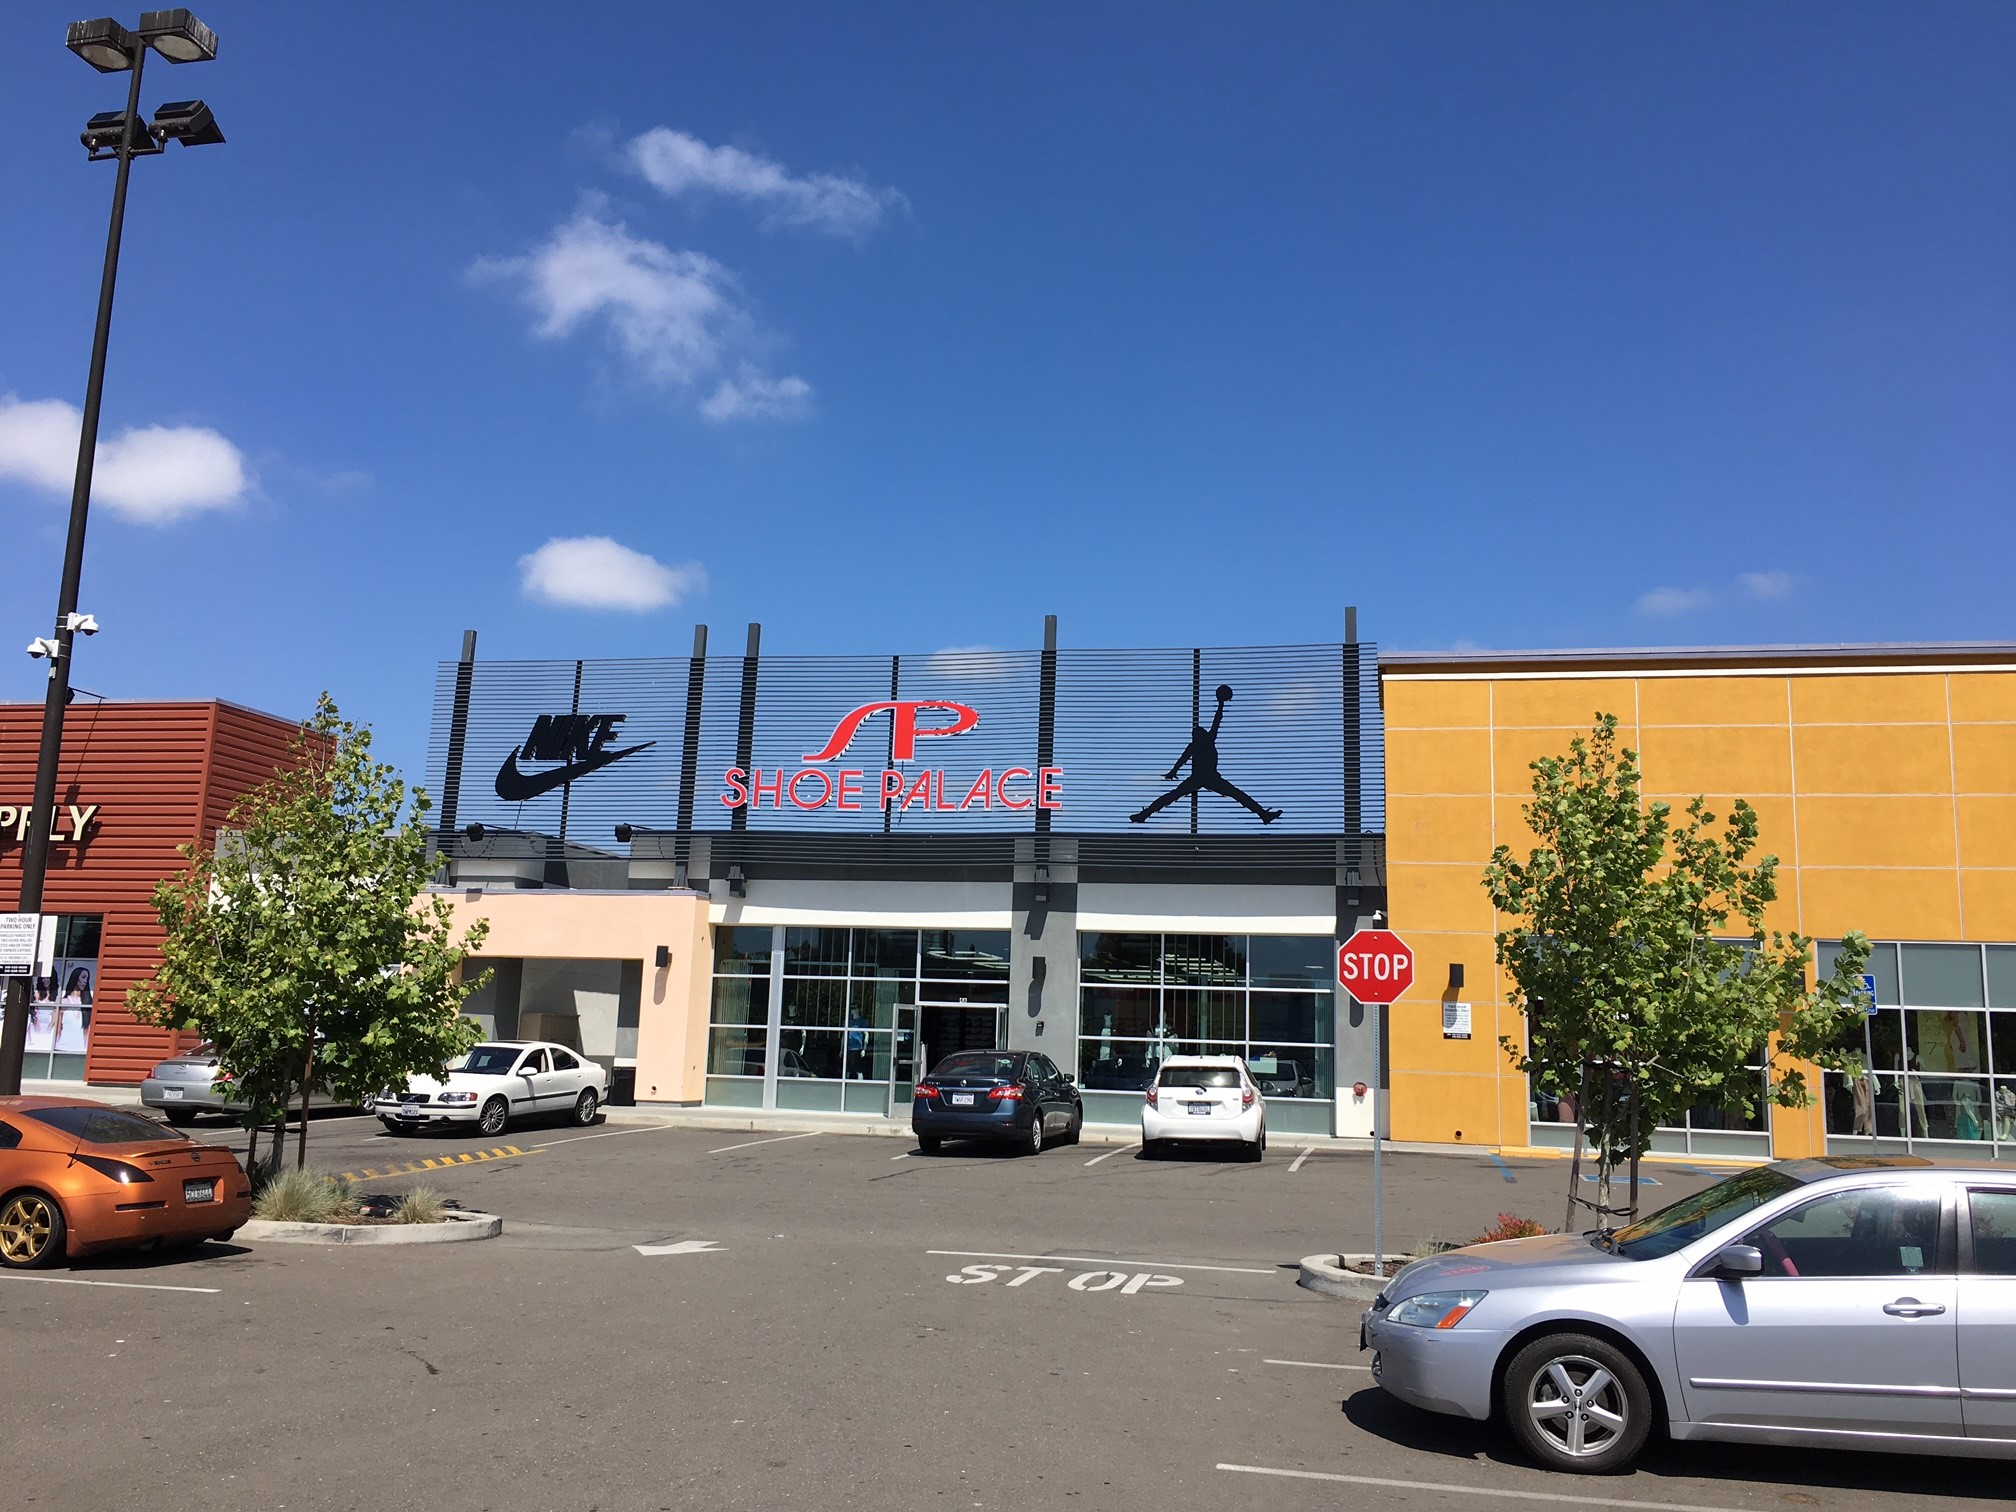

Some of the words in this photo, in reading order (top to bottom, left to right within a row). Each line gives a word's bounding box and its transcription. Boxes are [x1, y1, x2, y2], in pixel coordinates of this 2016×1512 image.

[519, 714, 627, 760] NIKE
[719, 766, 864, 812] SHOE
[879, 767, 1064, 812] PALACE
[1343, 952, 1409, 981] STOP
[946, 1264, 1185, 1295] STOP
